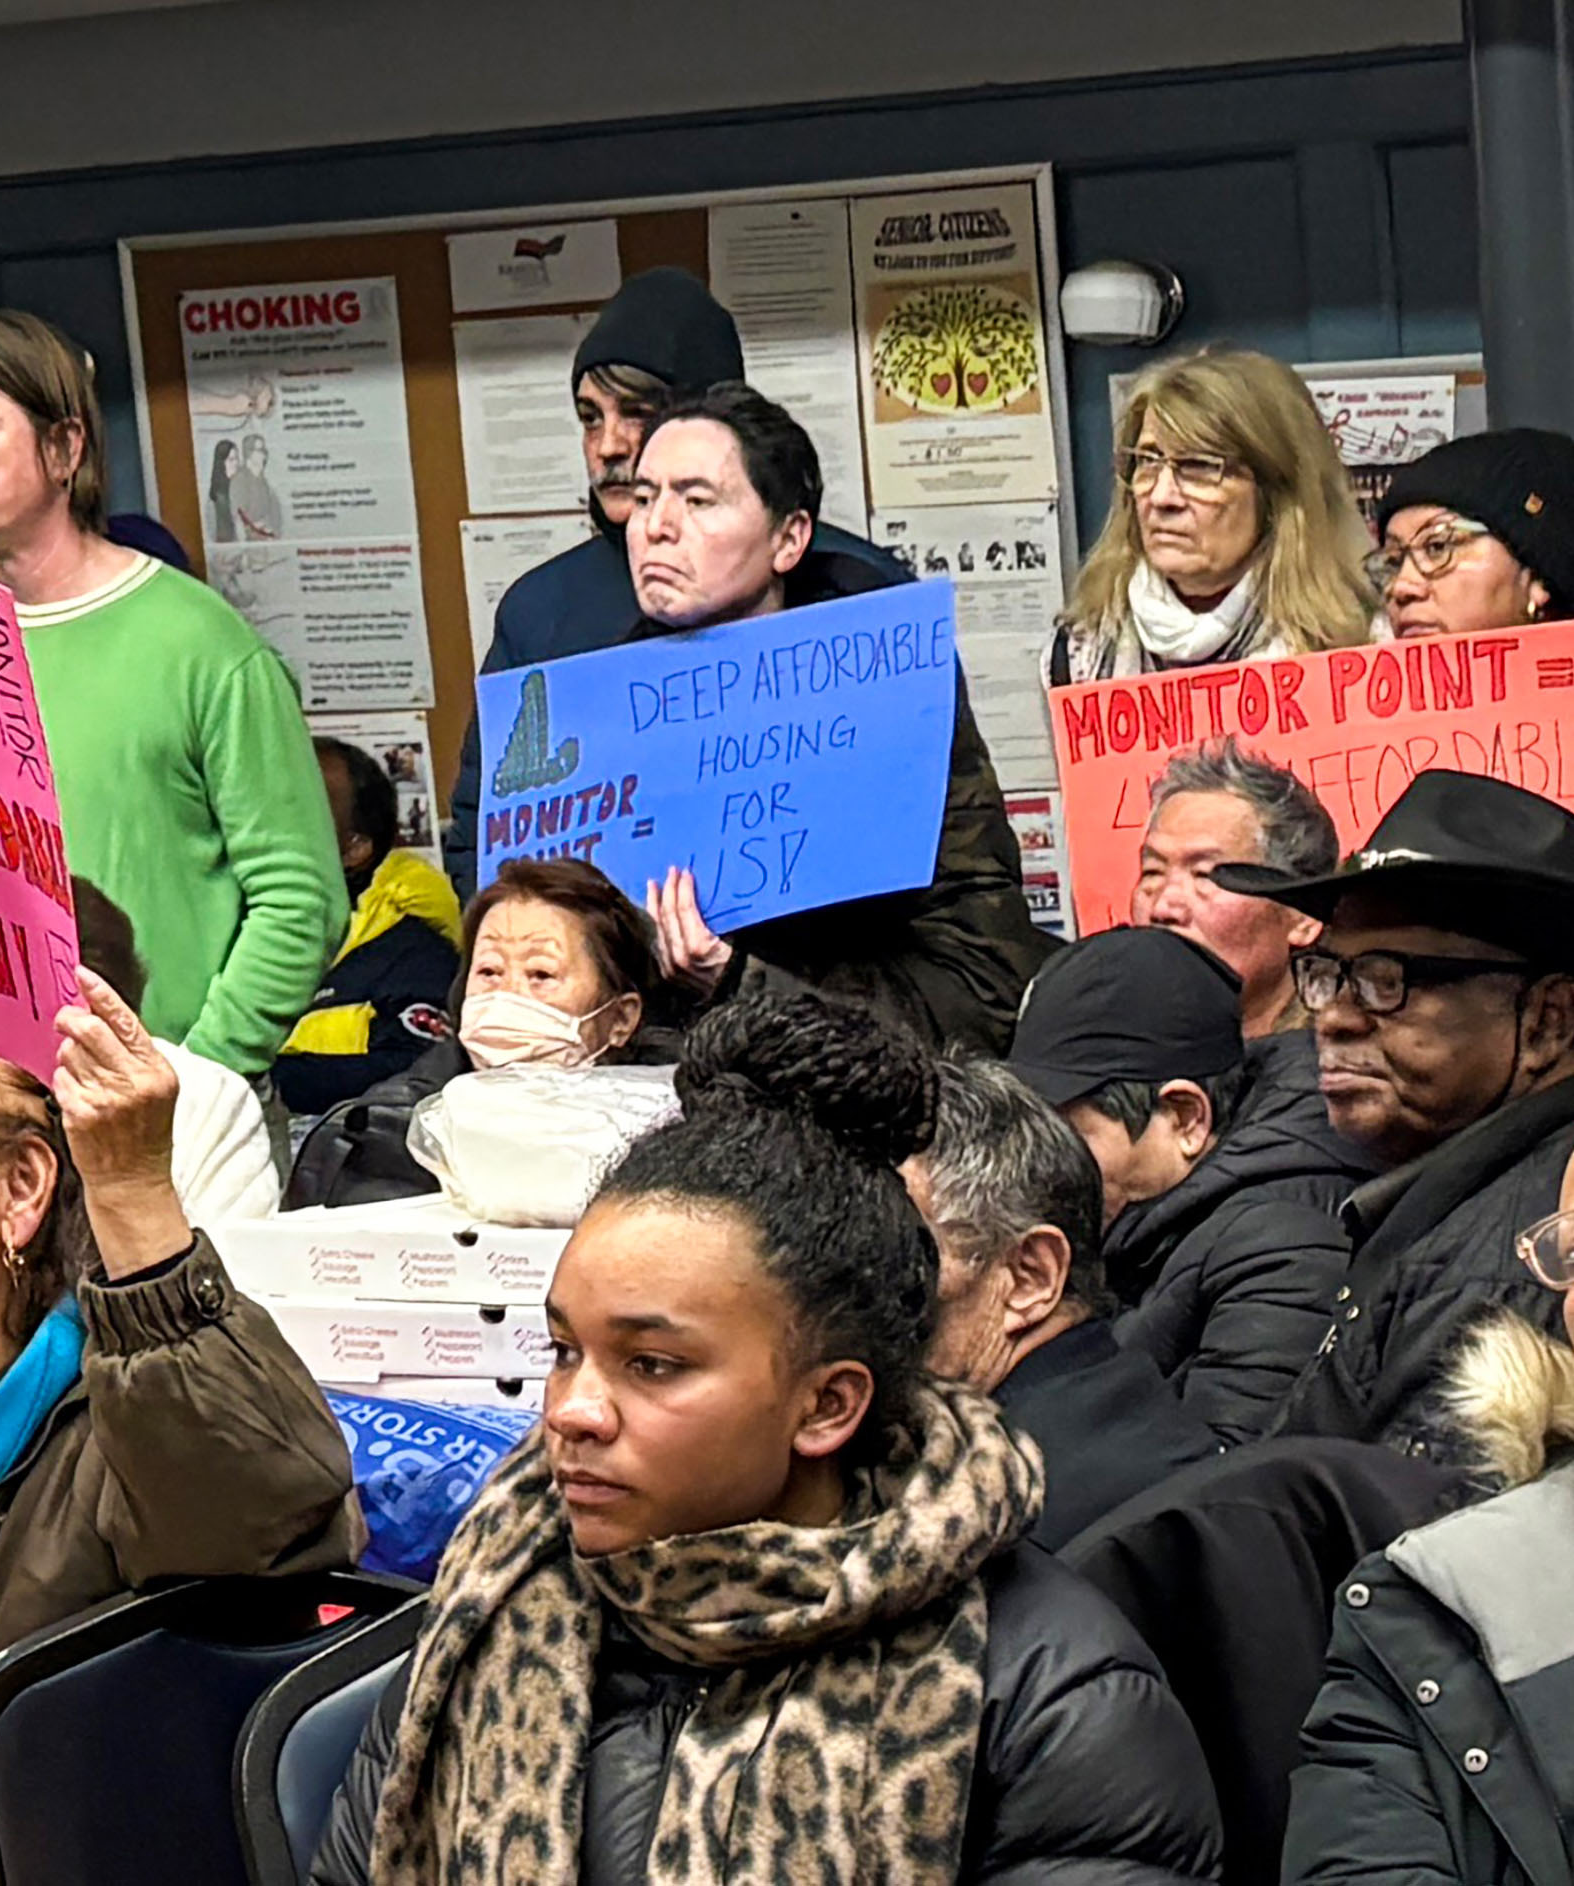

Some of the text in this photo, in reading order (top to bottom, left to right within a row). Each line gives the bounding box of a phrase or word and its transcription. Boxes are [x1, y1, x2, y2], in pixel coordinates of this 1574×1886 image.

[184, 291, 361, 334] CHOKING
[629, 617, 951, 734] DEEP AFFORDABLE
[1062, 661, 1310, 765] MONITOR
[1327, 637, 1520, 725] POINT
[696, 714, 857, 784] HOUSING
[484, 774, 639, 856] MONITOR
[720, 783, 799, 835] FOR
